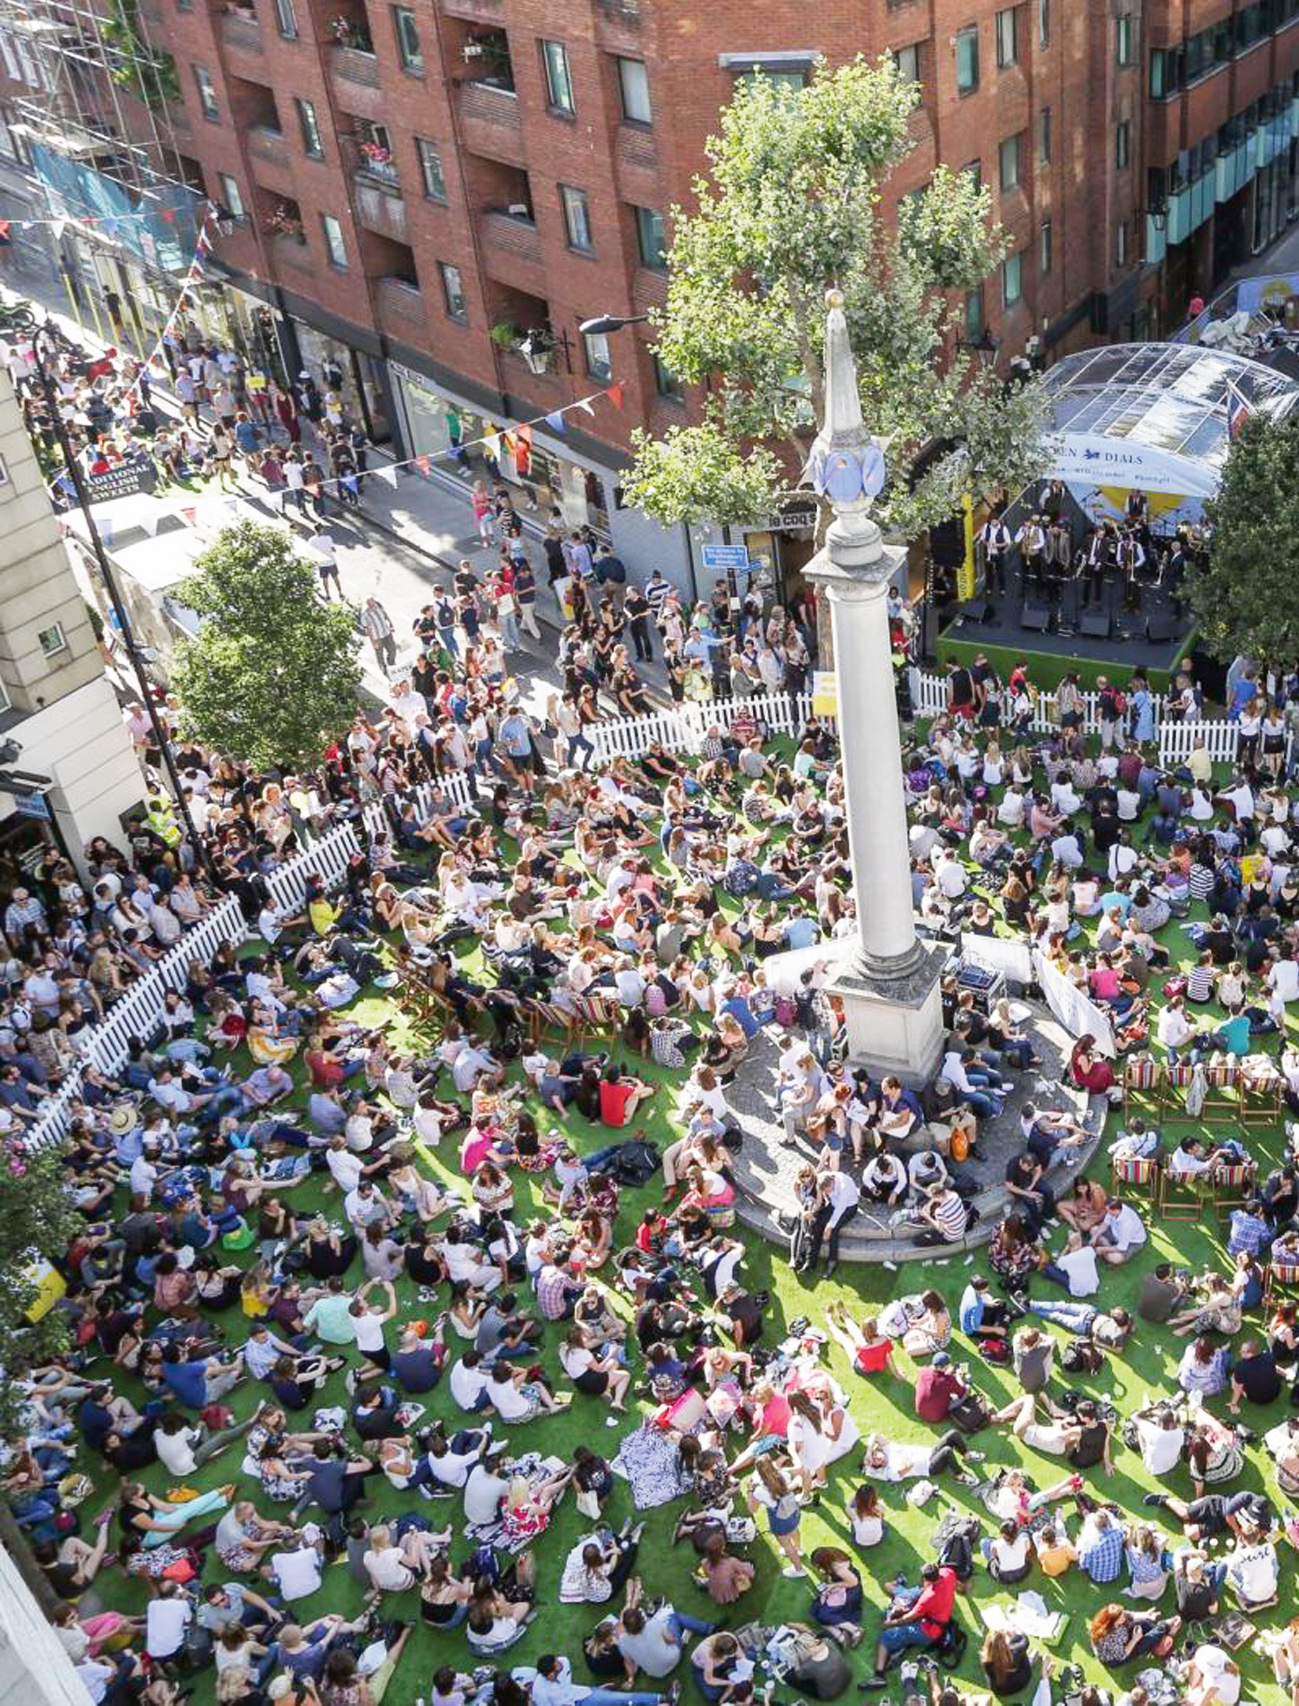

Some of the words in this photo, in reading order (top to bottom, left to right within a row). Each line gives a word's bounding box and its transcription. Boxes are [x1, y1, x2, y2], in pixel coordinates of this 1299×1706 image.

[1105, 453, 1143, 464] DIALS
[87, 475, 140, 494] ENGLISH
[91, 484, 140, 501] SWEETS
